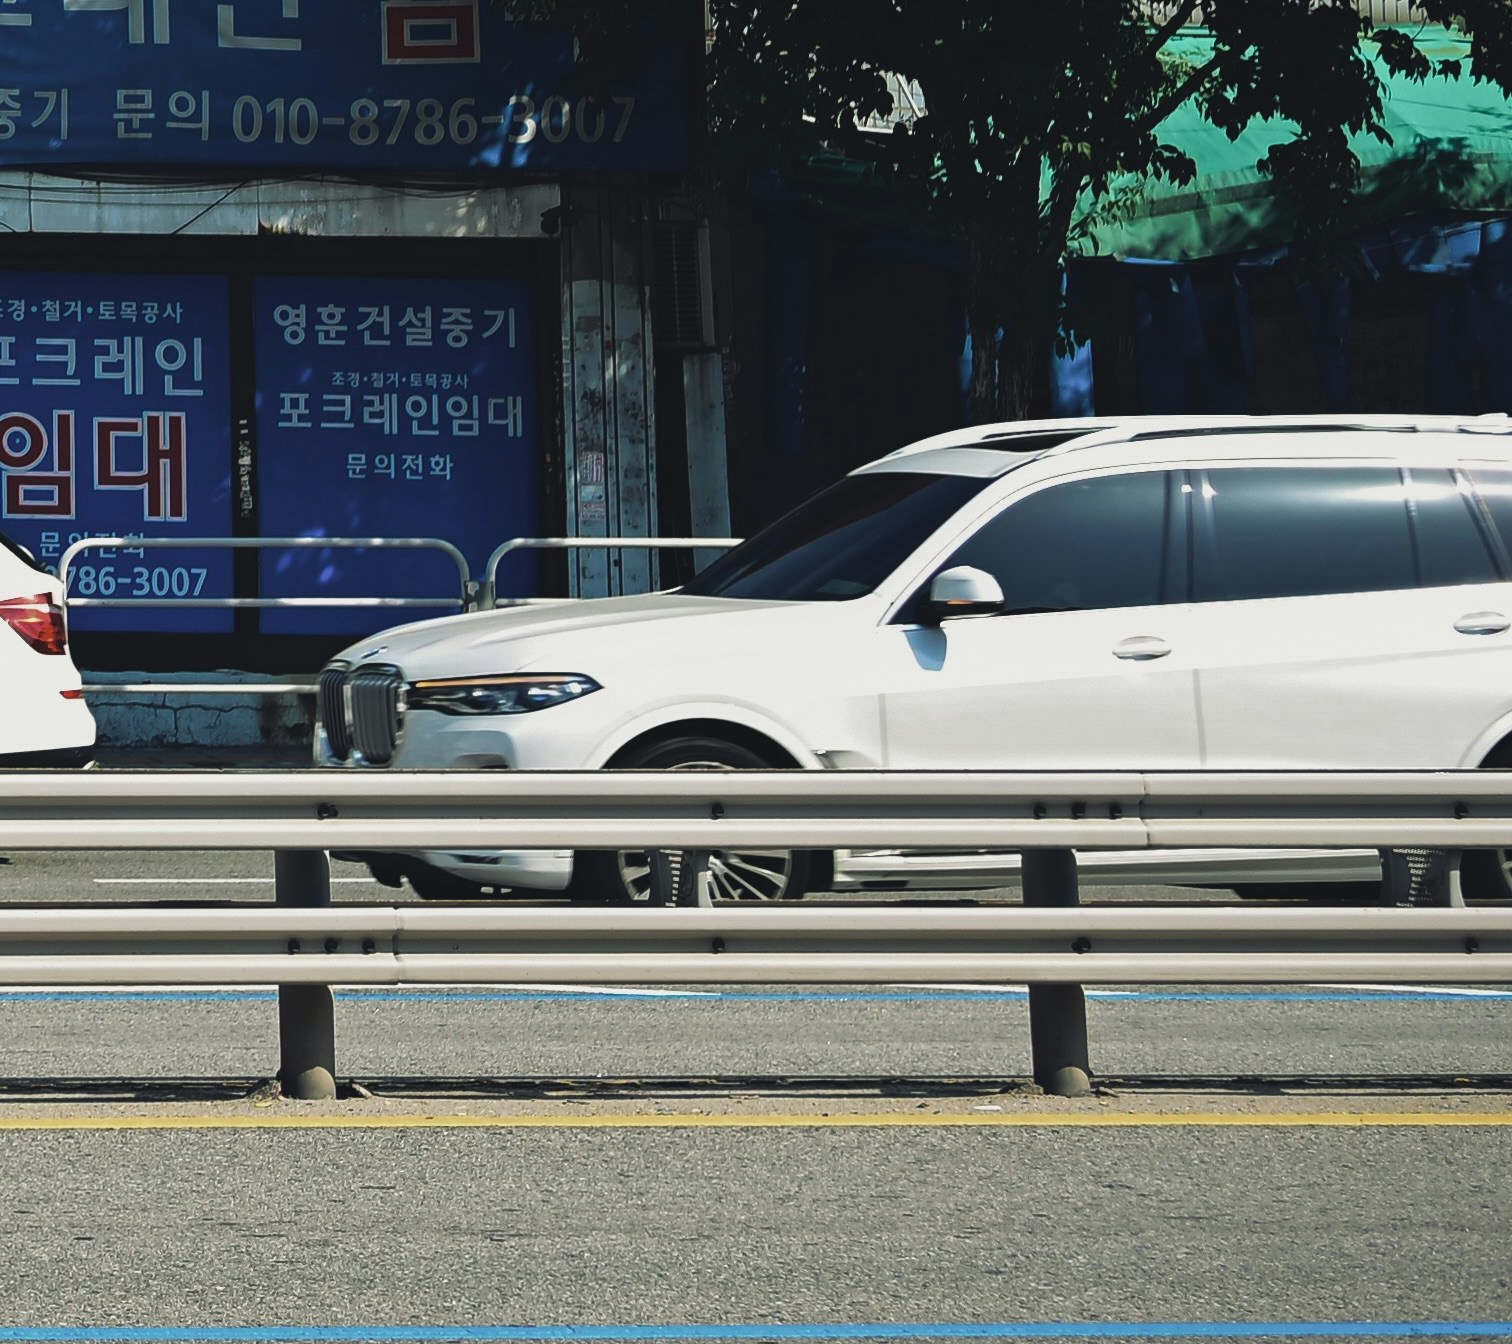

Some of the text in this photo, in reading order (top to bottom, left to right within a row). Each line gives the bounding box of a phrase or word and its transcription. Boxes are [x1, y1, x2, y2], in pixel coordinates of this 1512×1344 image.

[113, 87, 211, 142] 문의
[232, 95, 636, 147] 010-8786-3007
[273, 303, 516, 348] 영훈건설중기
[277, 392, 524, 438] 포크레인임대
[346, 453, 454, 481] 문의전화
